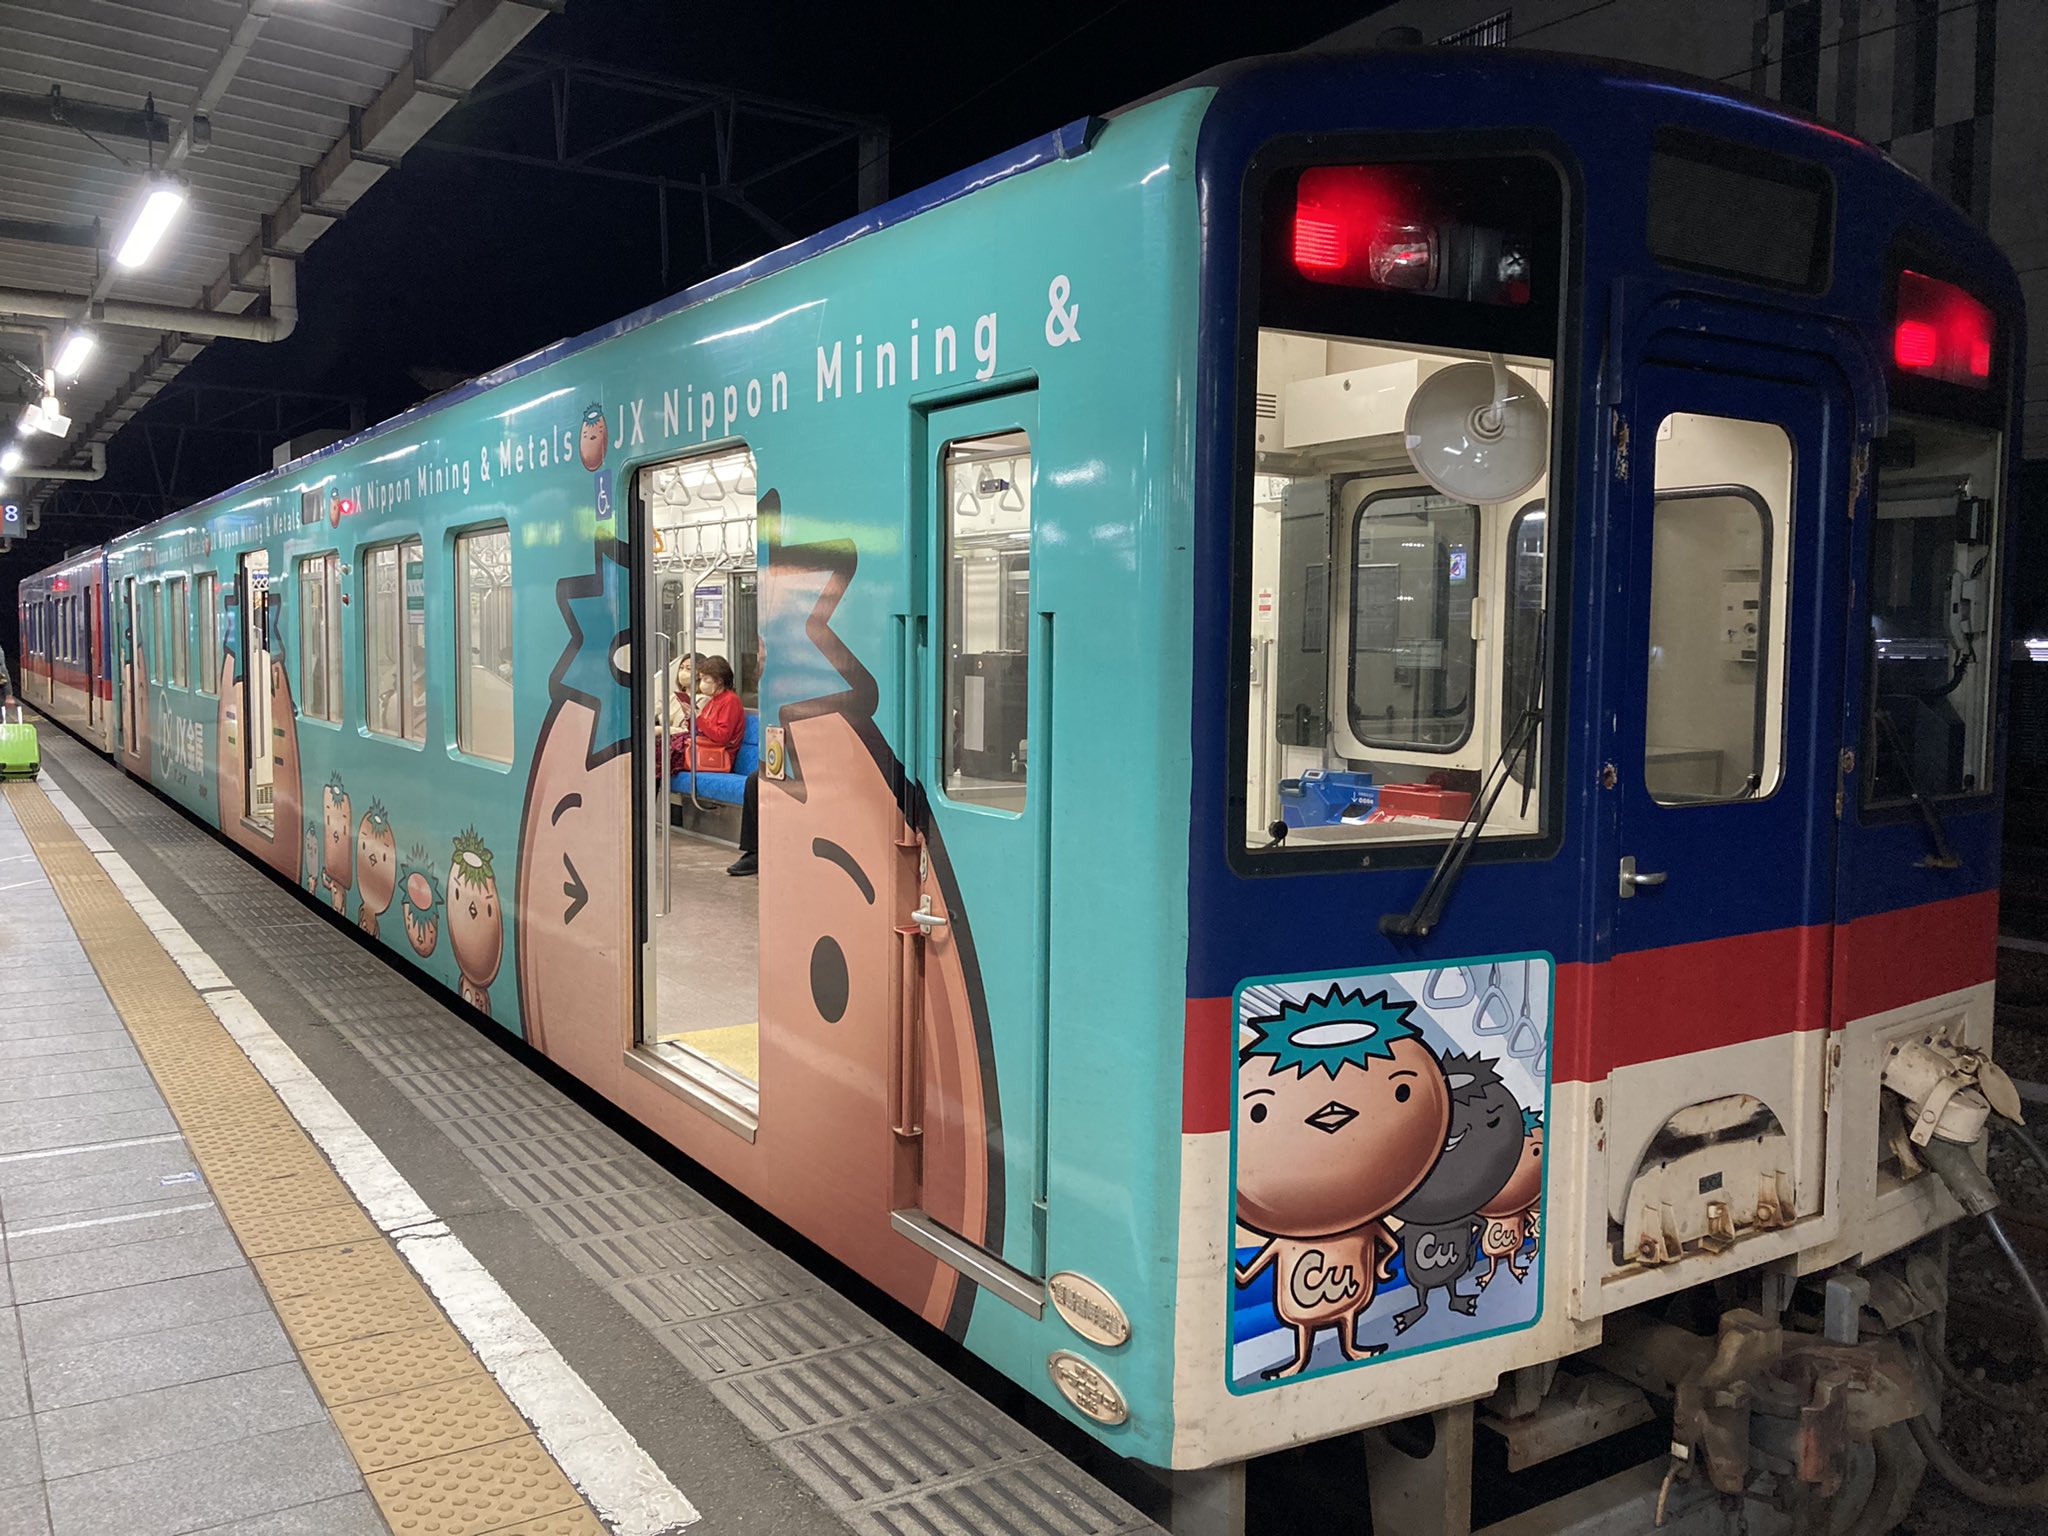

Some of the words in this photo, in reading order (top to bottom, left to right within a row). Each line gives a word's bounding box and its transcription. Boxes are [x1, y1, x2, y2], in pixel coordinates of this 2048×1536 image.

[614, 398, 644, 449] JX
[663, 369, 789, 442] Nippon
[816, 312, 998, 402] Mining
[1044, 274, 1082, 347] &
[367, 478, 411, 514] Nippon
[418, 457, 470, 498] Mining
[480, 446, 491, 481] &
[500, 425, 573, 477] Metals
[5, 505, 18, 522] 8
[273, 507, 300, 536] Metals
[1415, 1233, 1459, 1270] Cu
[1488, 1222, 1518, 1248] Cu
[1290, 1249, 1360, 1309] Cu
